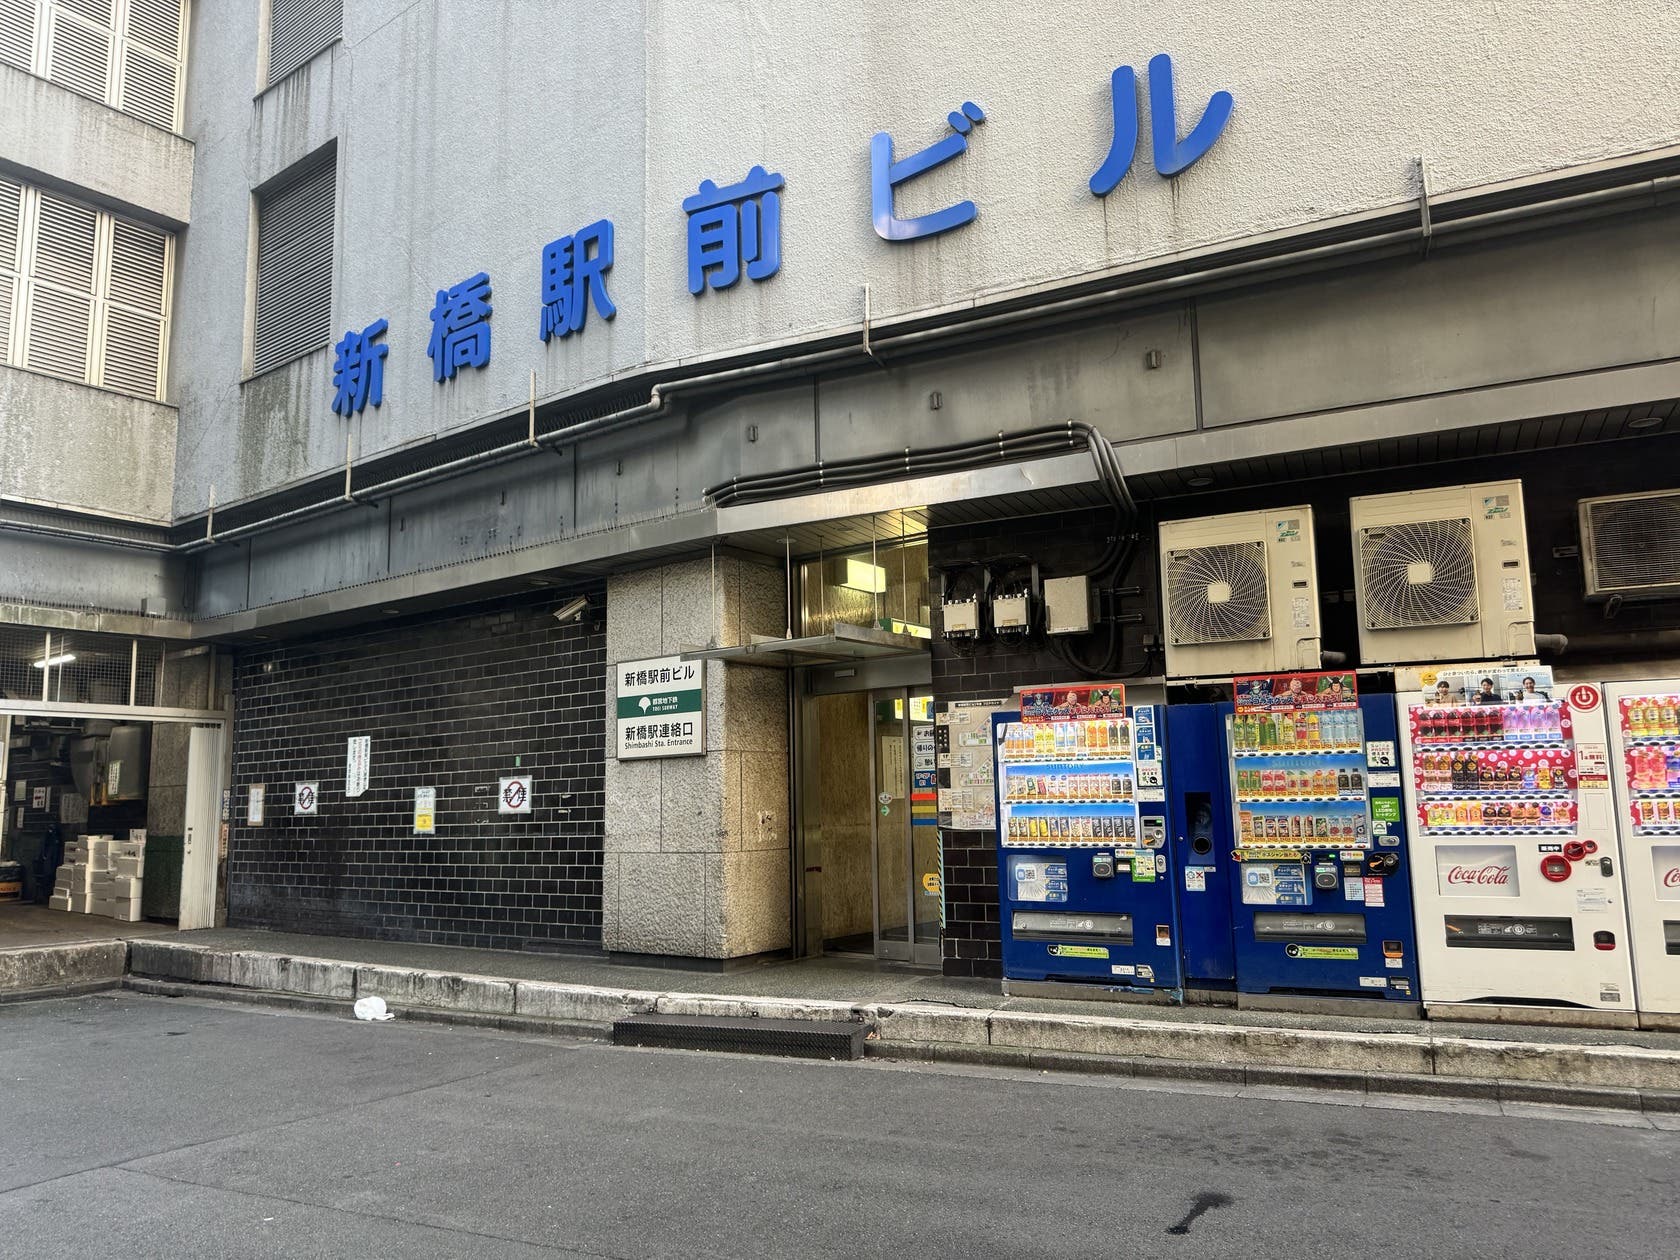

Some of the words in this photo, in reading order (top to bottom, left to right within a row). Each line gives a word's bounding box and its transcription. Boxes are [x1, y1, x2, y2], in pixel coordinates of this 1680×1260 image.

[332, 52, 1234, 418] 新橋駅前ビル
[625, 665, 695, 687] 新橋駅前ビル
[652, 696, 678, 705] 都営地下鉄
[625, 722, 693, 741] 新橋駅連絡口
[667, 738, 693, 747] Entrance
[1448, 865, 1512, 885] Coca-Cola
